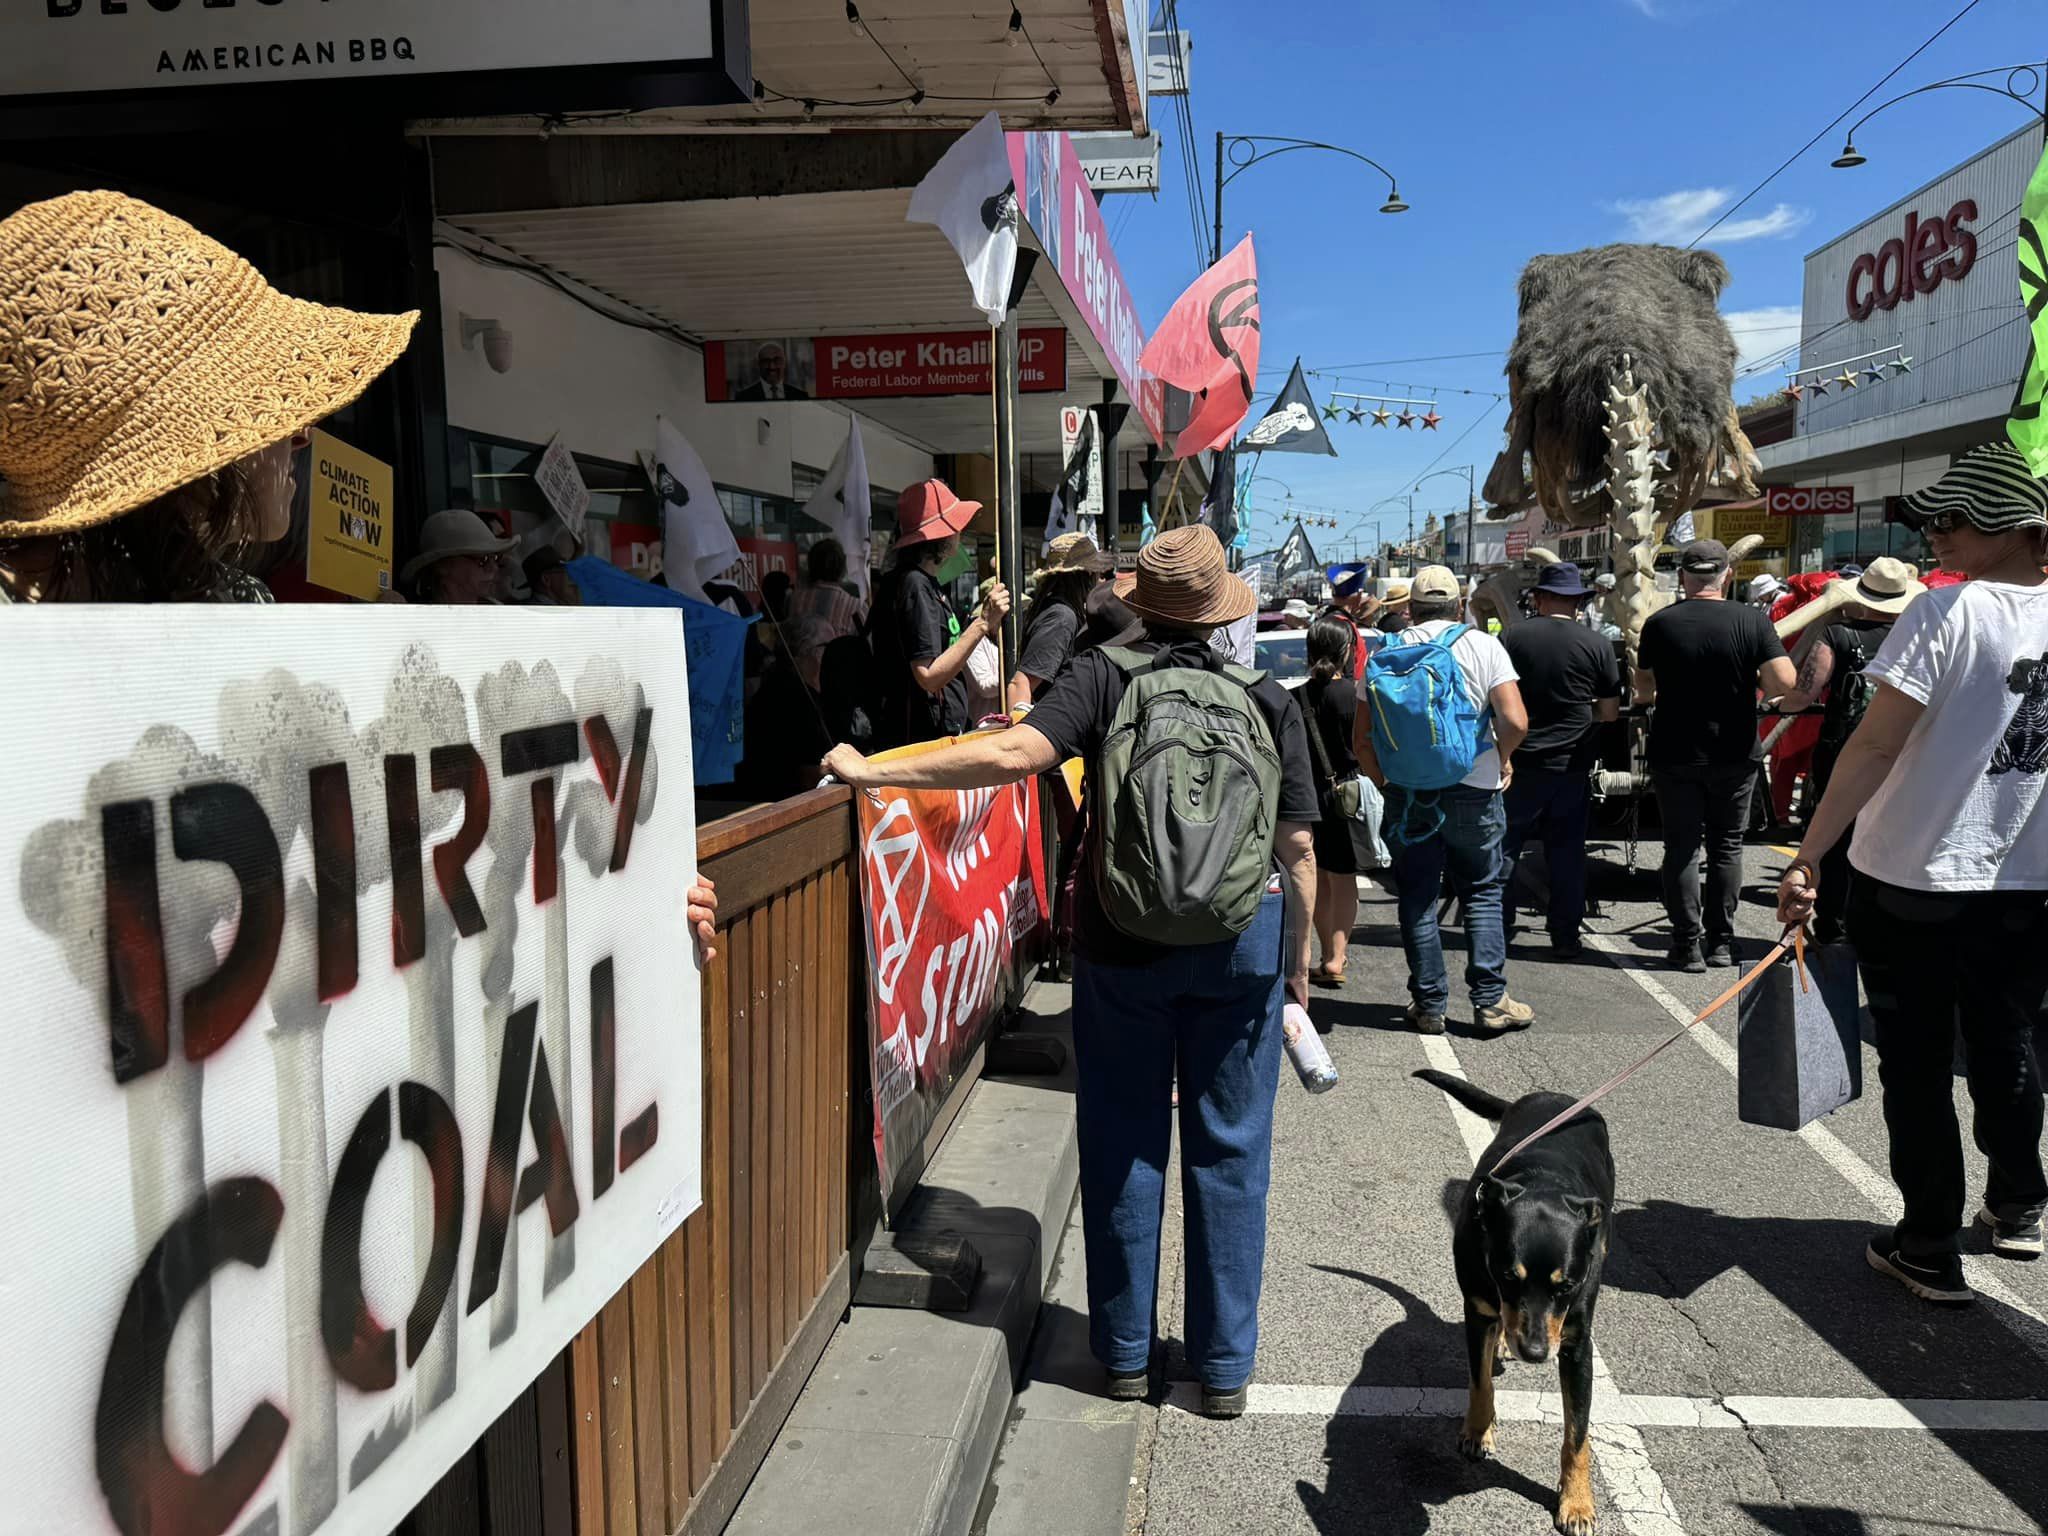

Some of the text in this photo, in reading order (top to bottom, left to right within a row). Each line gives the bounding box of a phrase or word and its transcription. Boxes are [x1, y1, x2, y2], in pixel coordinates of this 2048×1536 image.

[157, 36, 416, 73] AMERICAN BBQ
[1075, 180, 1108, 331] Peter
[1846, 199, 1978, 322] coles
[831, 346, 906, 370] Peter
[917, 340, 993, 367] Khalil
[832, 375, 881, 389] Federal
[885, 373, 922, 388] Labor
[927, 370, 980, 385] Member
[1018, 368, 1045, 382] ills
[320, 459, 370, 494] CLIMATE
[329, 483, 380, 520] ACTION
[1772, 488, 1851, 511] coles
[101, 706, 654, 1085] DIRTY
[95, 954, 659, 1536] COAL
